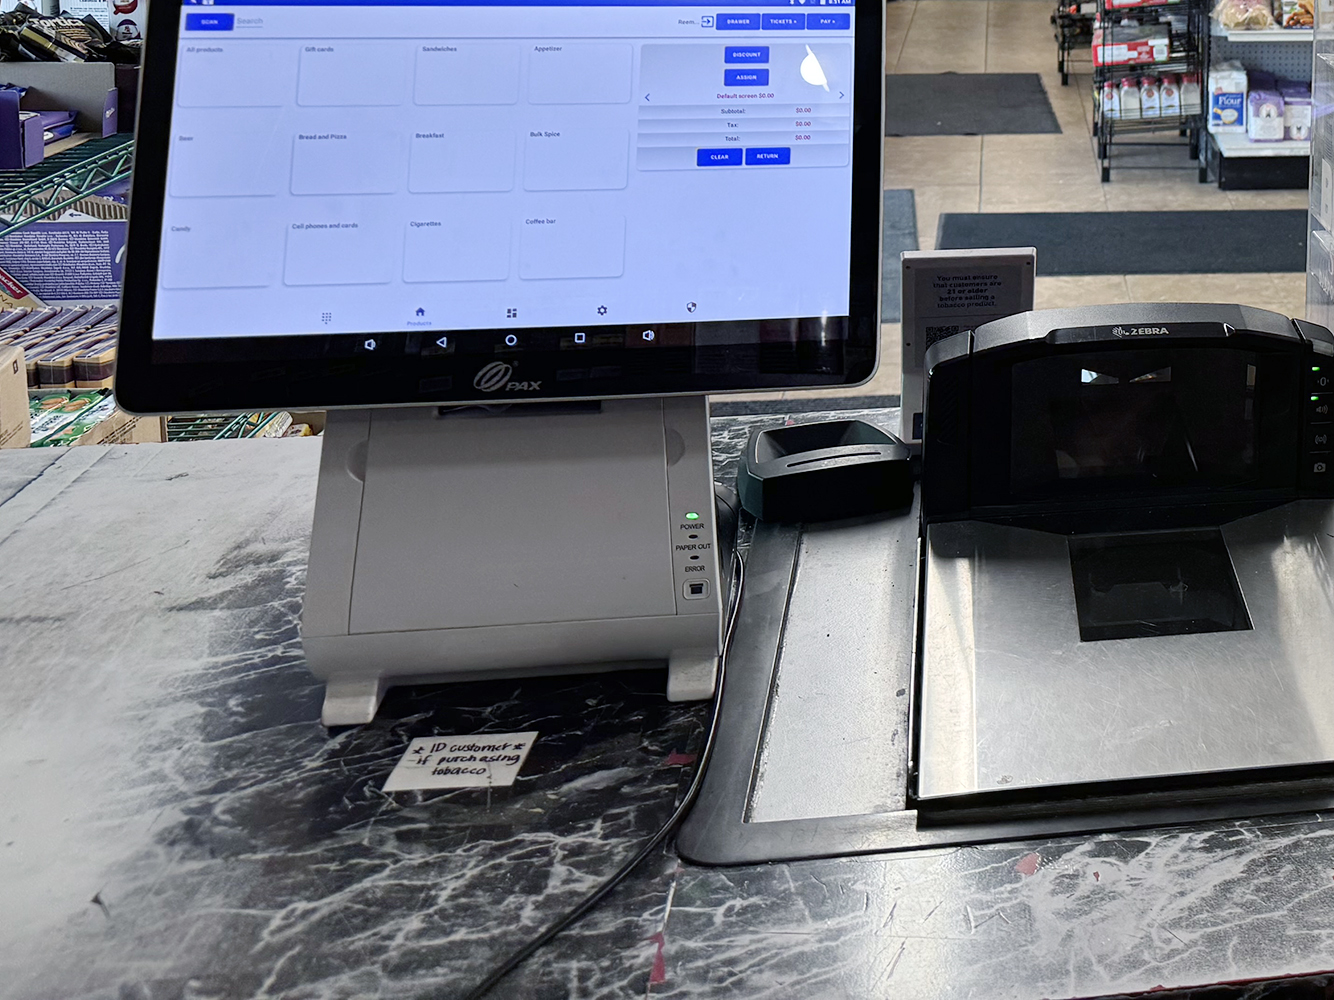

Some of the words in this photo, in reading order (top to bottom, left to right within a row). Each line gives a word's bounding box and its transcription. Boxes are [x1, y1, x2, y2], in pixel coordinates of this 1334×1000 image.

[237, 17, 263, 25] Search
[1219, 96, 1242, 105] Flour
[305, 223, 328, 231] phones
[410, 220, 441, 228] Cigarettes
[964, 295, 988, 303] selling
[966, 301, 998, 309] product.
[1131, 326, 1169, 336] ZEBRA
[505, 381, 542, 391] PAX
[431, 742, 446, 754] ID
[449, 742, 511, 754] customer
[437, 753, 521, 767] purchasing
[431, 765, 487, 777] tobacco
